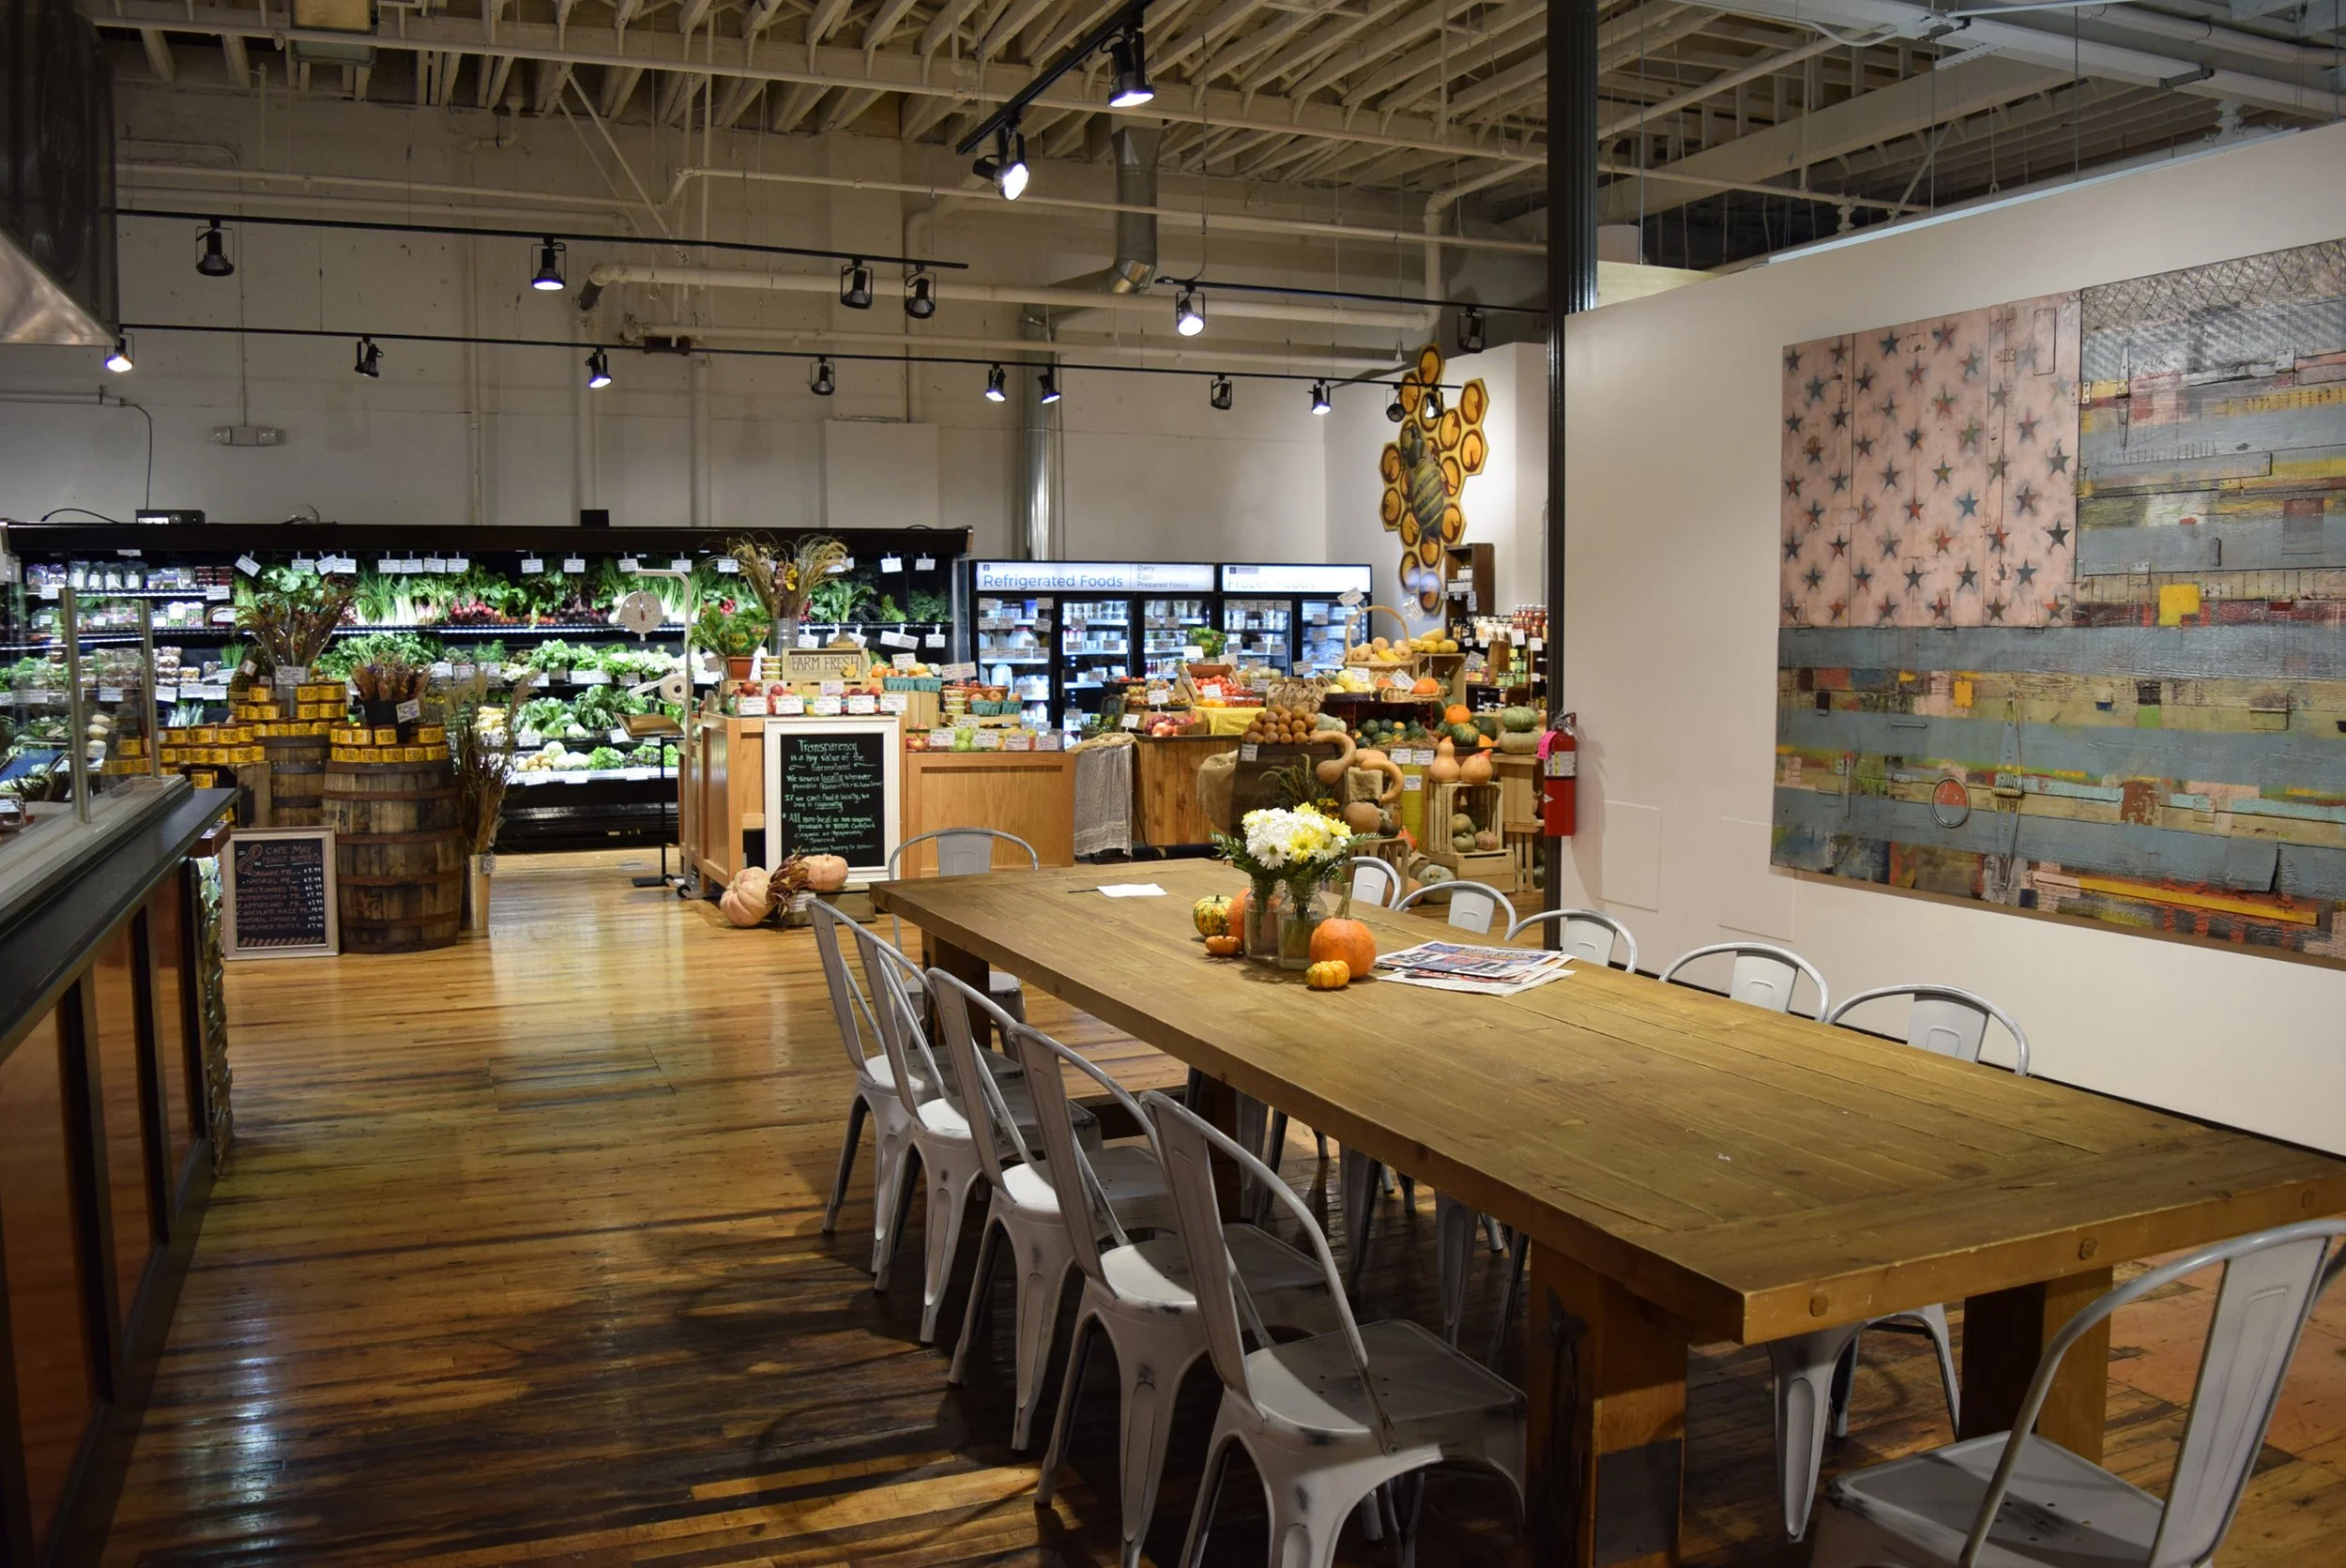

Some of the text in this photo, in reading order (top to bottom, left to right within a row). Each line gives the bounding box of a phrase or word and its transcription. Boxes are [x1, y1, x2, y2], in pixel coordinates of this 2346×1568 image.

[983, 574, 1123, 590] Refrigerated Foods
[792, 656, 859, 671] FARM FRESH
[798, 739, 858, 755] Transparency
[821, 753, 840, 761] value
[841, 753, 849, 761] of
[786, 773, 797, 782] We
[821, 772, 844, 783] locally
[788, 813, 800, 823] All
[266, 845, 313, 855] CAPE MAY
